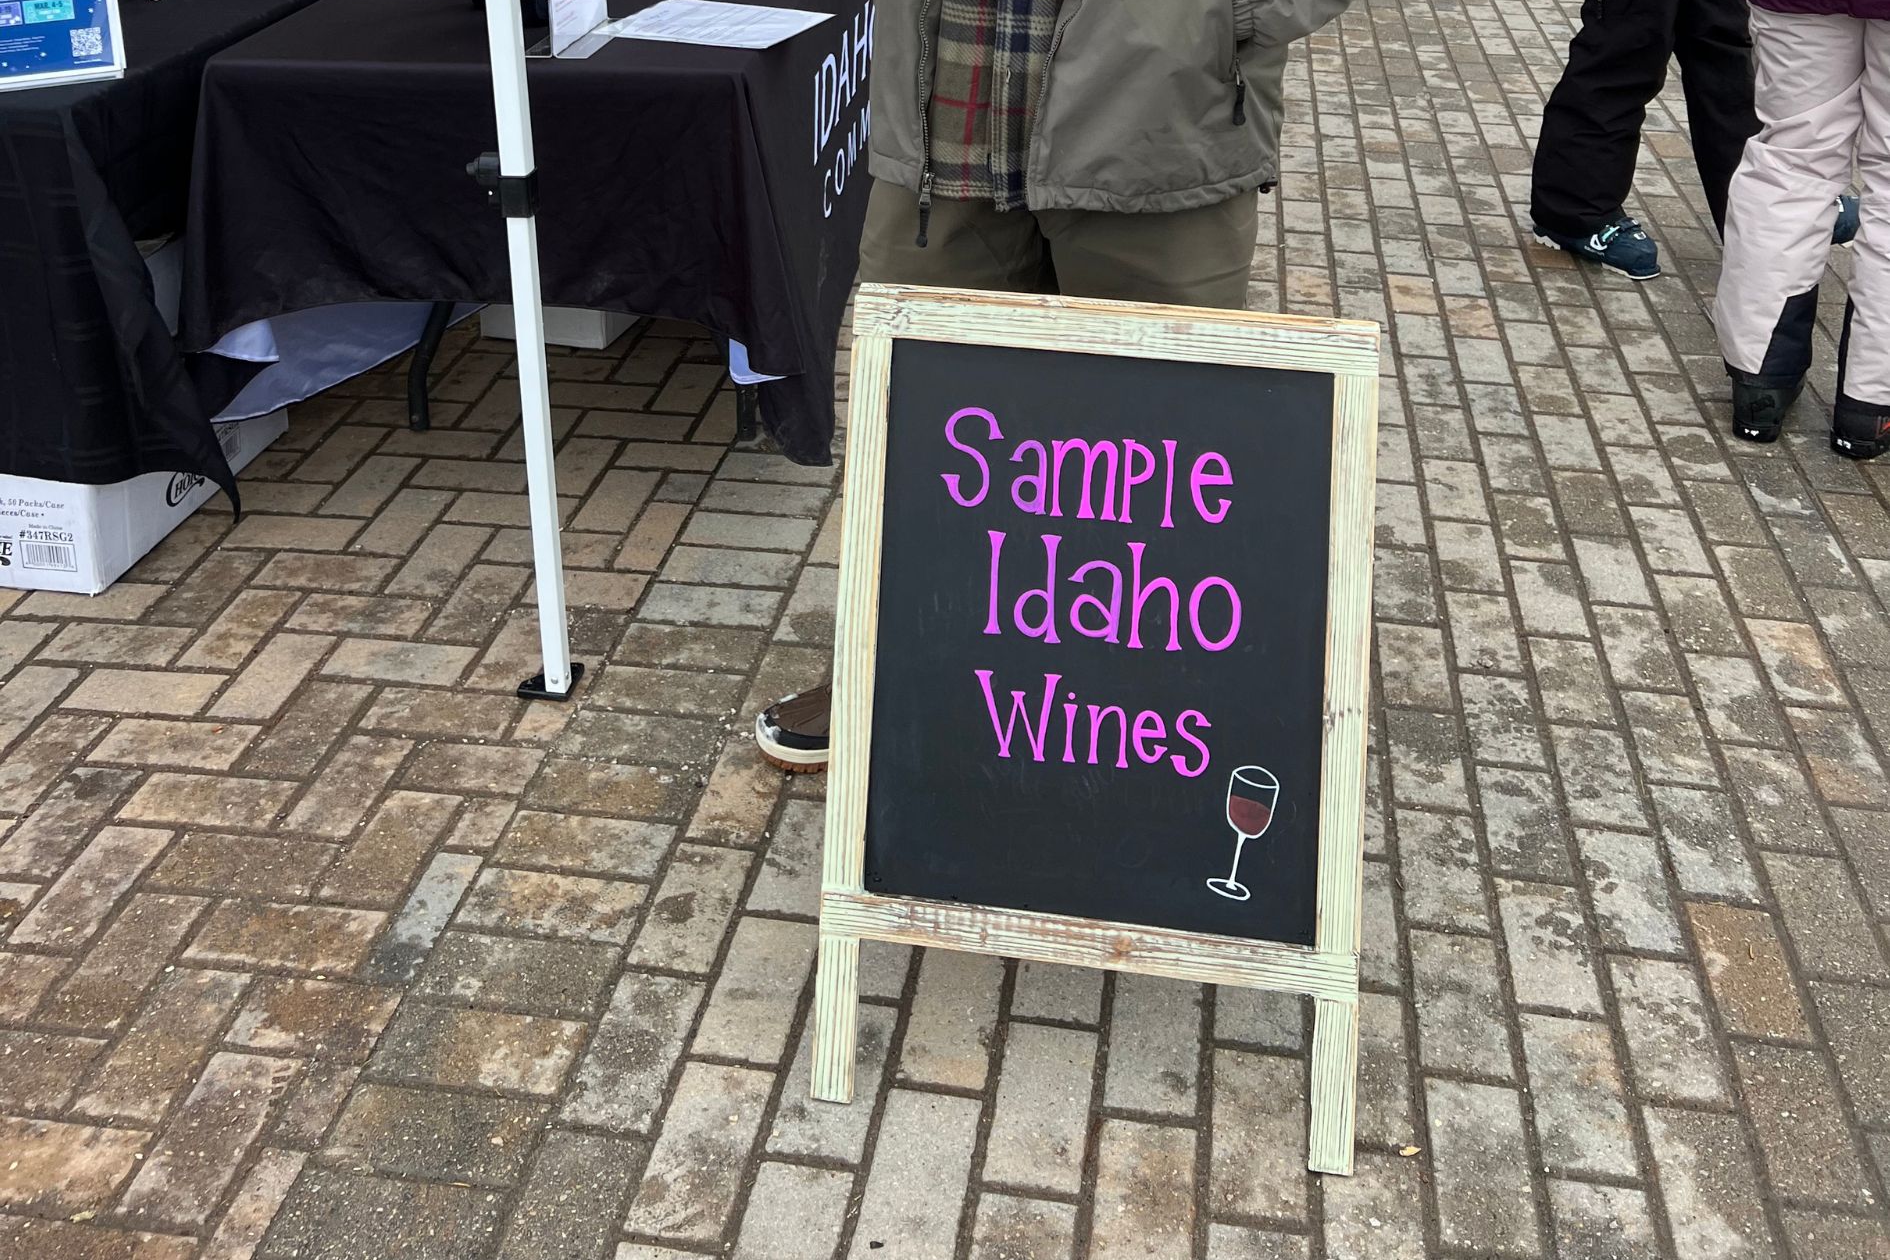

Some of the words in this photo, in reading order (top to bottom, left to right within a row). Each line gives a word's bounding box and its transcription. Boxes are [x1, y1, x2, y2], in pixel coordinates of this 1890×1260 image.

[823, 100, 872, 219] COMM
[940, 406, 1234, 528] Sample
[19, 530, 74, 542] #347RSG2
[983, 530, 1242, 652] Idaho
[974, 670, 1212, 777] Wines
